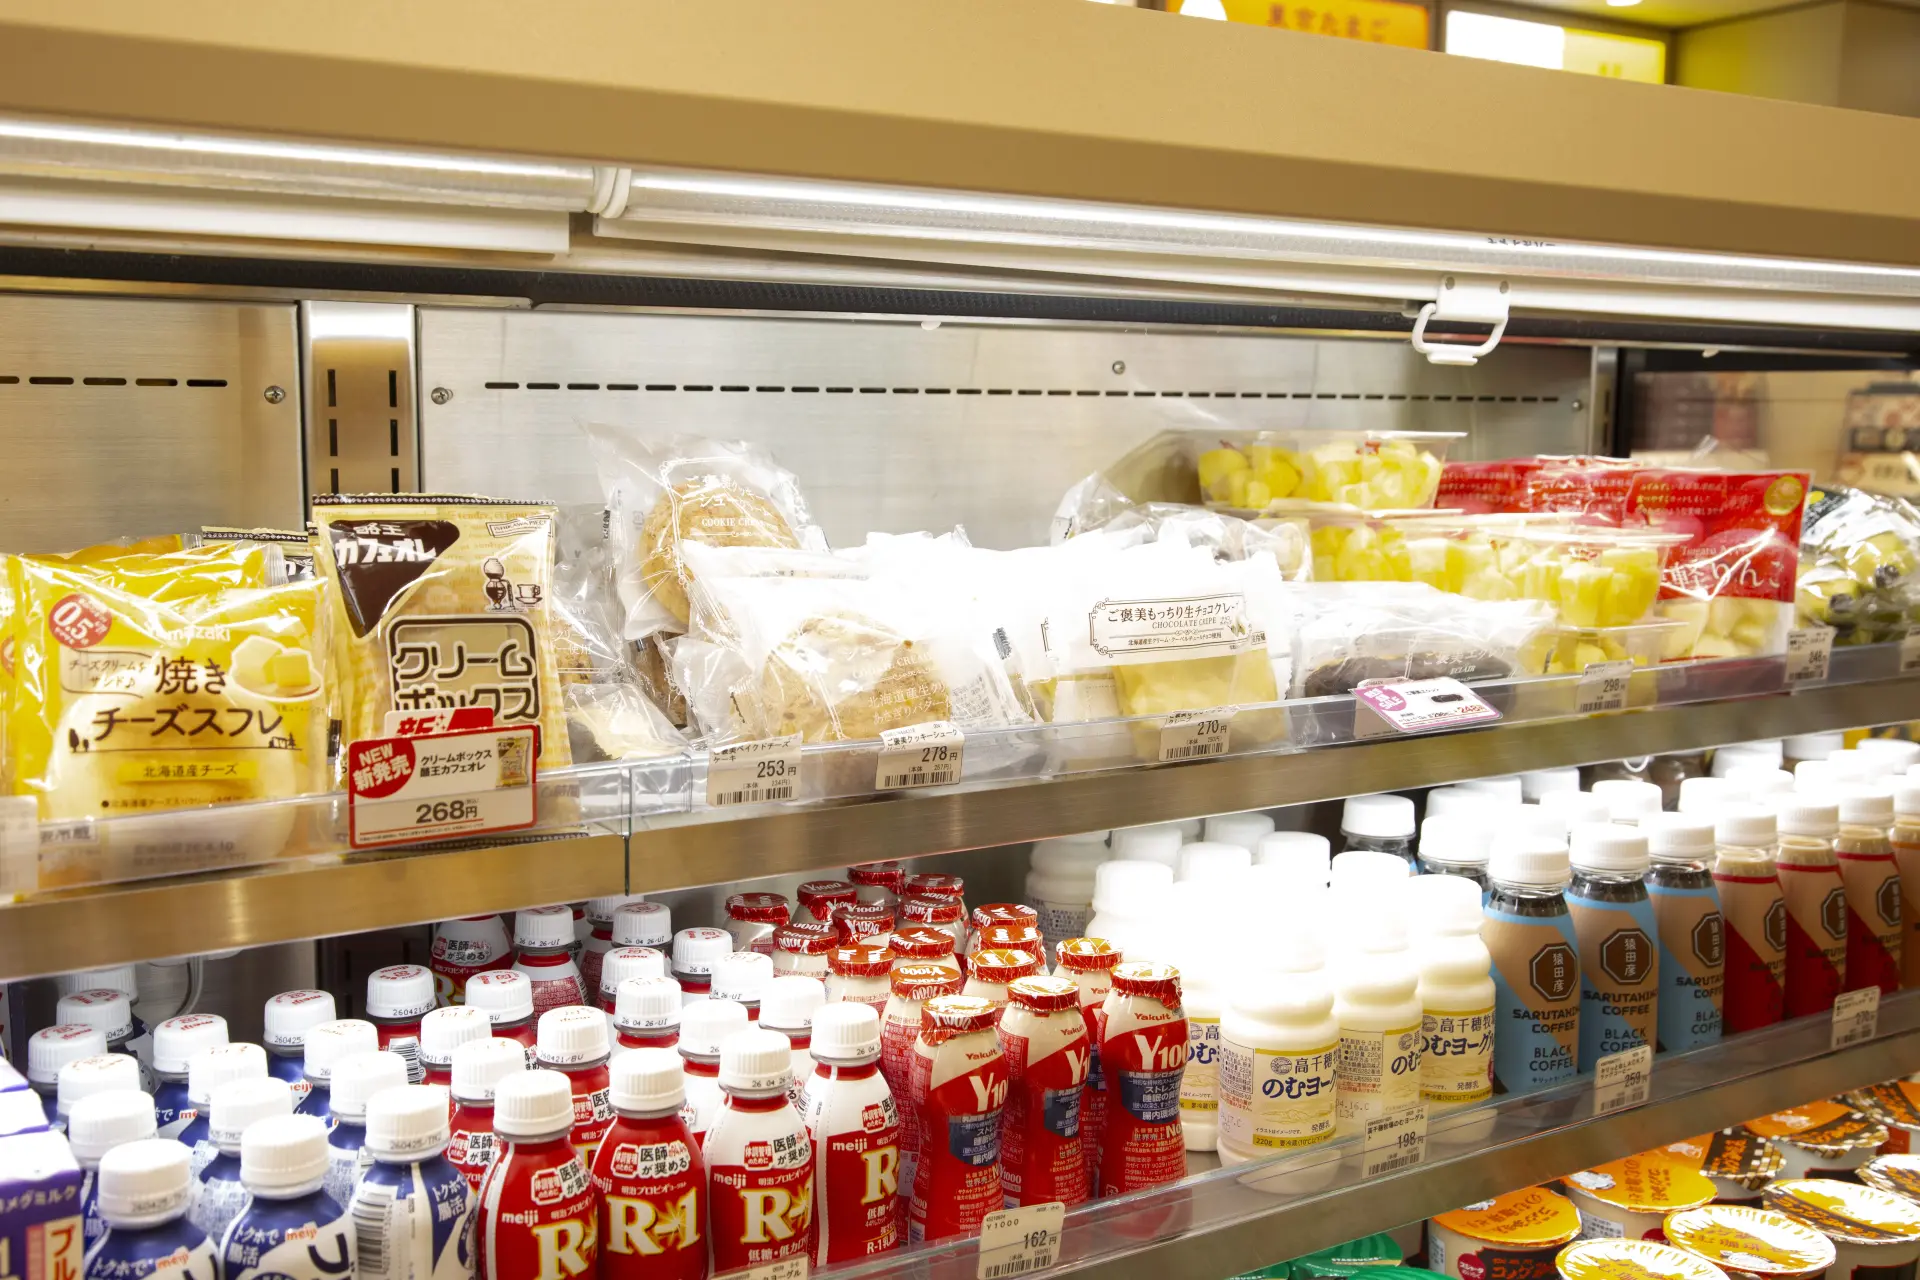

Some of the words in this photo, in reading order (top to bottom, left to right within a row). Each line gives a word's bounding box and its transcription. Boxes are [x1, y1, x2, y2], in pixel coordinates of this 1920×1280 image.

[336, 538, 437, 567] カフェオレ
[1107, 602, 1239, 623] ご褒美もっちり生チョコクレー
[1152, 619, 1197, 630] CHOCOLATE
[396, 643, 533, 680] クリーム
[155, 656, 227, 696] 焼き
[92, 703, 284, 742] チーズスフレ
[358, 742, 393, 767] NEW
[420, 749, 493, 767] クリームボックス
[143, 762, 238, 779] 北海道産チーズ
[352, 755, 414, 791] 新発売
[1623, 937, 1637, 978] 猿田彦
[1552, 952, 1565, 994] 猿田彦
[1133, 1011, 1173, 1022] Yakult
[1602, 1003, 1652, 1017] COFFEE
[1531, 1020, 1576, 1035] COFFEE
[1603, 1026, 1648, 1041] BLACK
[965, 1049, 999, 1062] Yakult
[1533, 1044, 1573, 1060] BLACK
[1529, 1055, 1574, 1073] COFFEE
[1456, 1080, 1480, 1091] 発酵乳
[773, 1133, 797, 1153] 医師
[832, 1137, 868, 1154] meiji
[1255, 1137, 1273, 1148] 220g
[640, 1146, 668, 1162] 医師
[641, 1156, 688, 1176] が奨める
[713, 1171, 748, 1189] meiji
[501, 1208, 539, 1228] meiji
[604, 1186, 701, 1256] R-1
